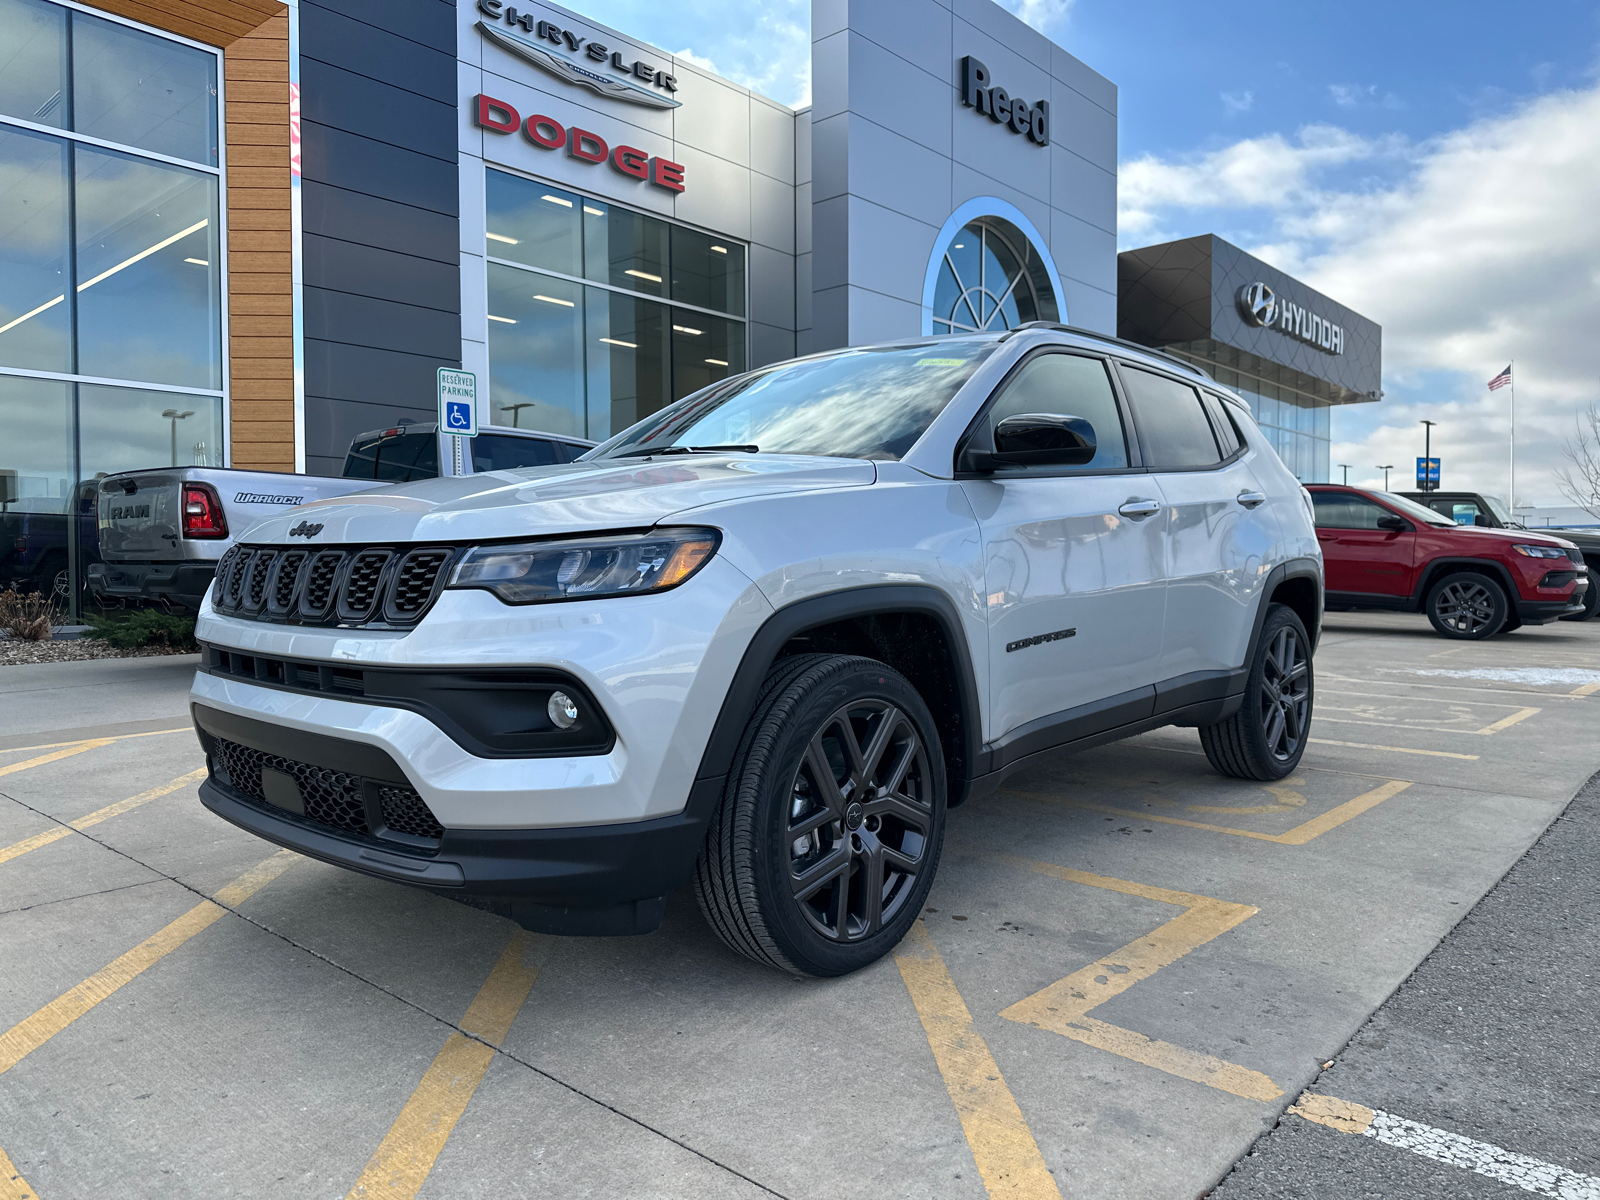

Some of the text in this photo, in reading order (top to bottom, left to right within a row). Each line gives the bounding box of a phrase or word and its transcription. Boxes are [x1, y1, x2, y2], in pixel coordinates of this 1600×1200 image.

[477, 0, 678, 92] CHRYSLER
[961, 54, 1050, 147] Reed
[474, 93, 685, 193] DODGE
[1281, 299, 1344, 355] HYUNDAI
[441, 374, 474, 387] RESERVED
[441, 386, 474, 398] PARKING
[233, 492, 304, 506] WARLOCK
[110, 504, 150, 520] RAM
[289, 520, 325, 540] Jeep
[1006, 627, 1077, 653] COMPASS
